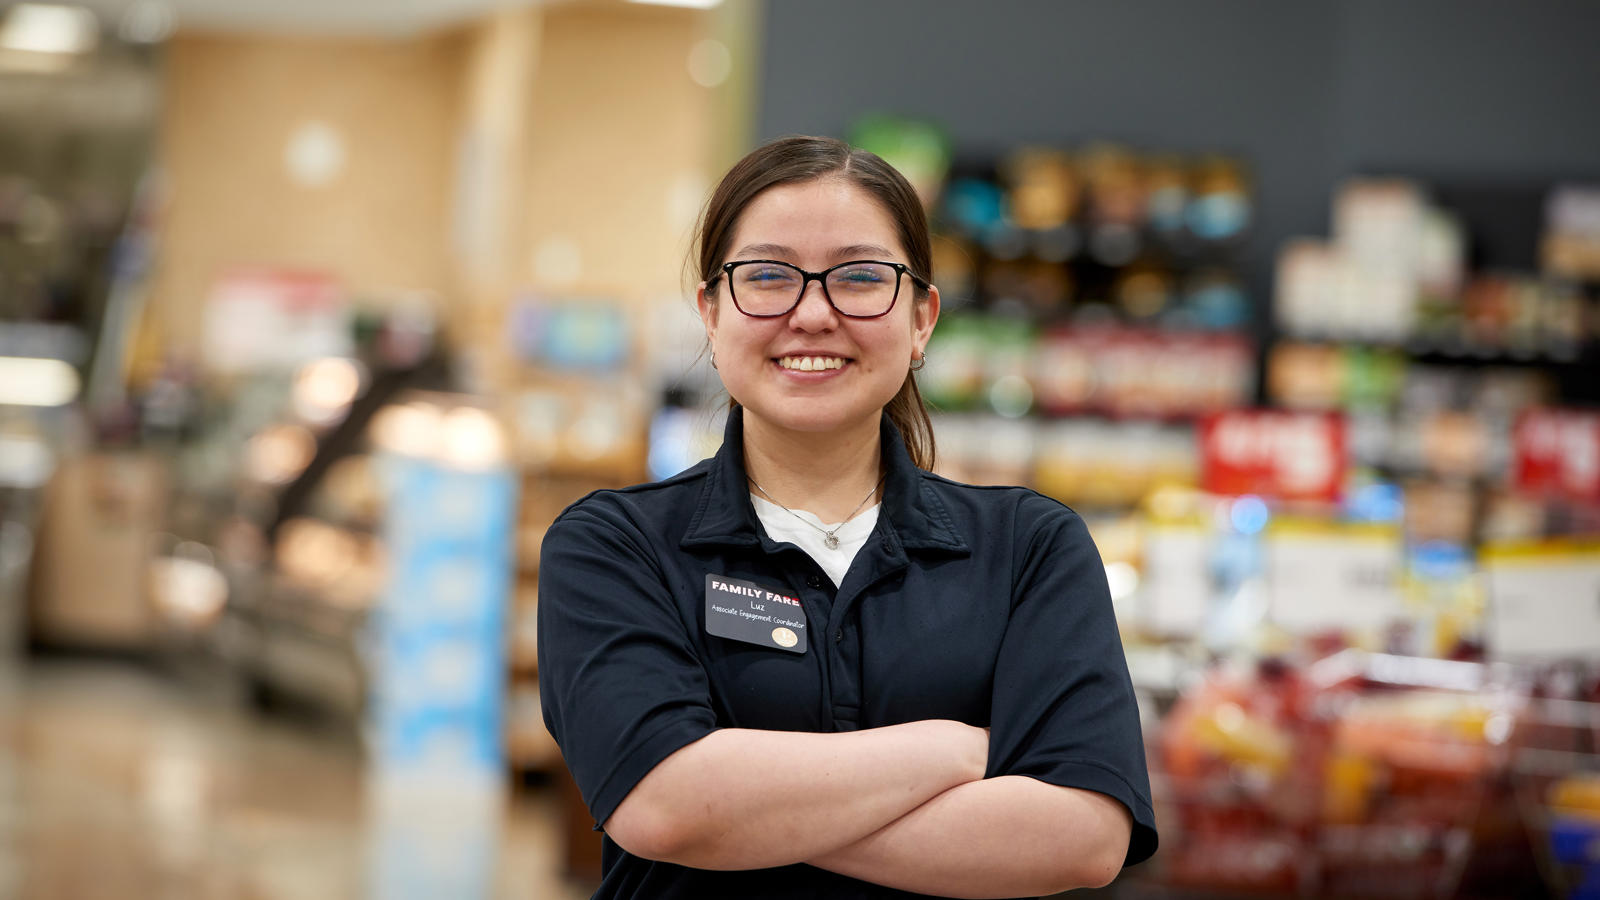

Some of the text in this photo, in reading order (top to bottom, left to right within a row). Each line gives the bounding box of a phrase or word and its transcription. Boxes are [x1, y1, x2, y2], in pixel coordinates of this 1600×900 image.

[712, 581, 800, 606] FAMILY FARE
[750, 601, 766, 611] Luz
[711, 604, 805, 629] Associate Engagement Coordinator
